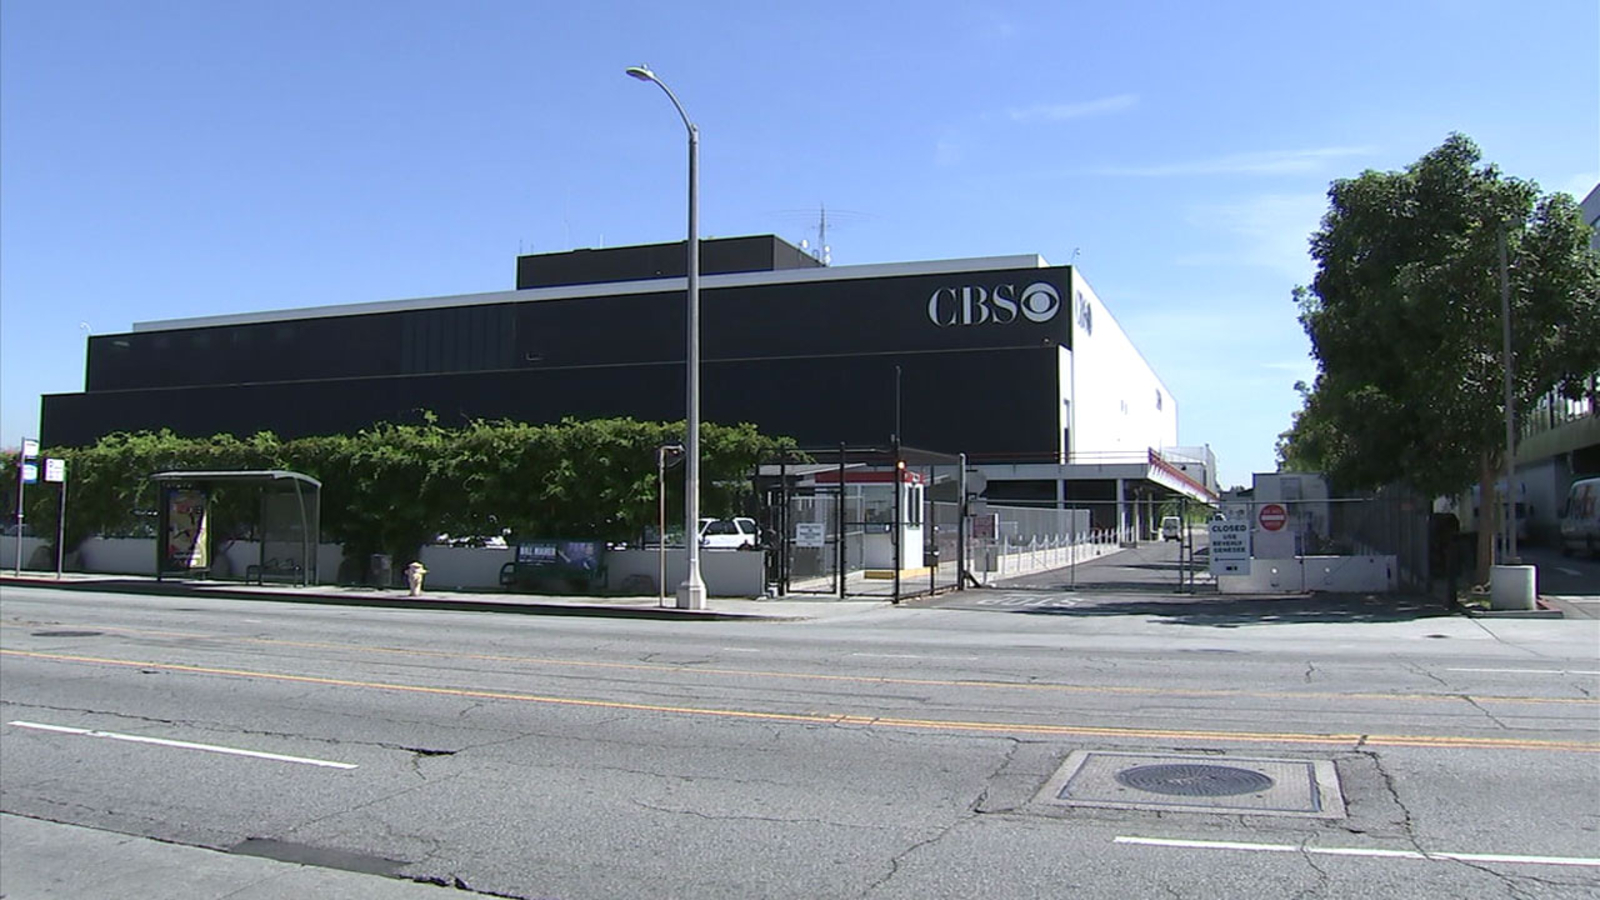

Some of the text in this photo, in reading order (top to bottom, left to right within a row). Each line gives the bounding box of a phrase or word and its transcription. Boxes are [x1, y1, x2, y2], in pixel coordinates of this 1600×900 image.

[928, 283, 1018, 327] CBS
[1211, 524, 1247, 533] CLOSED
[977, 597, 1084, 607] STOP
